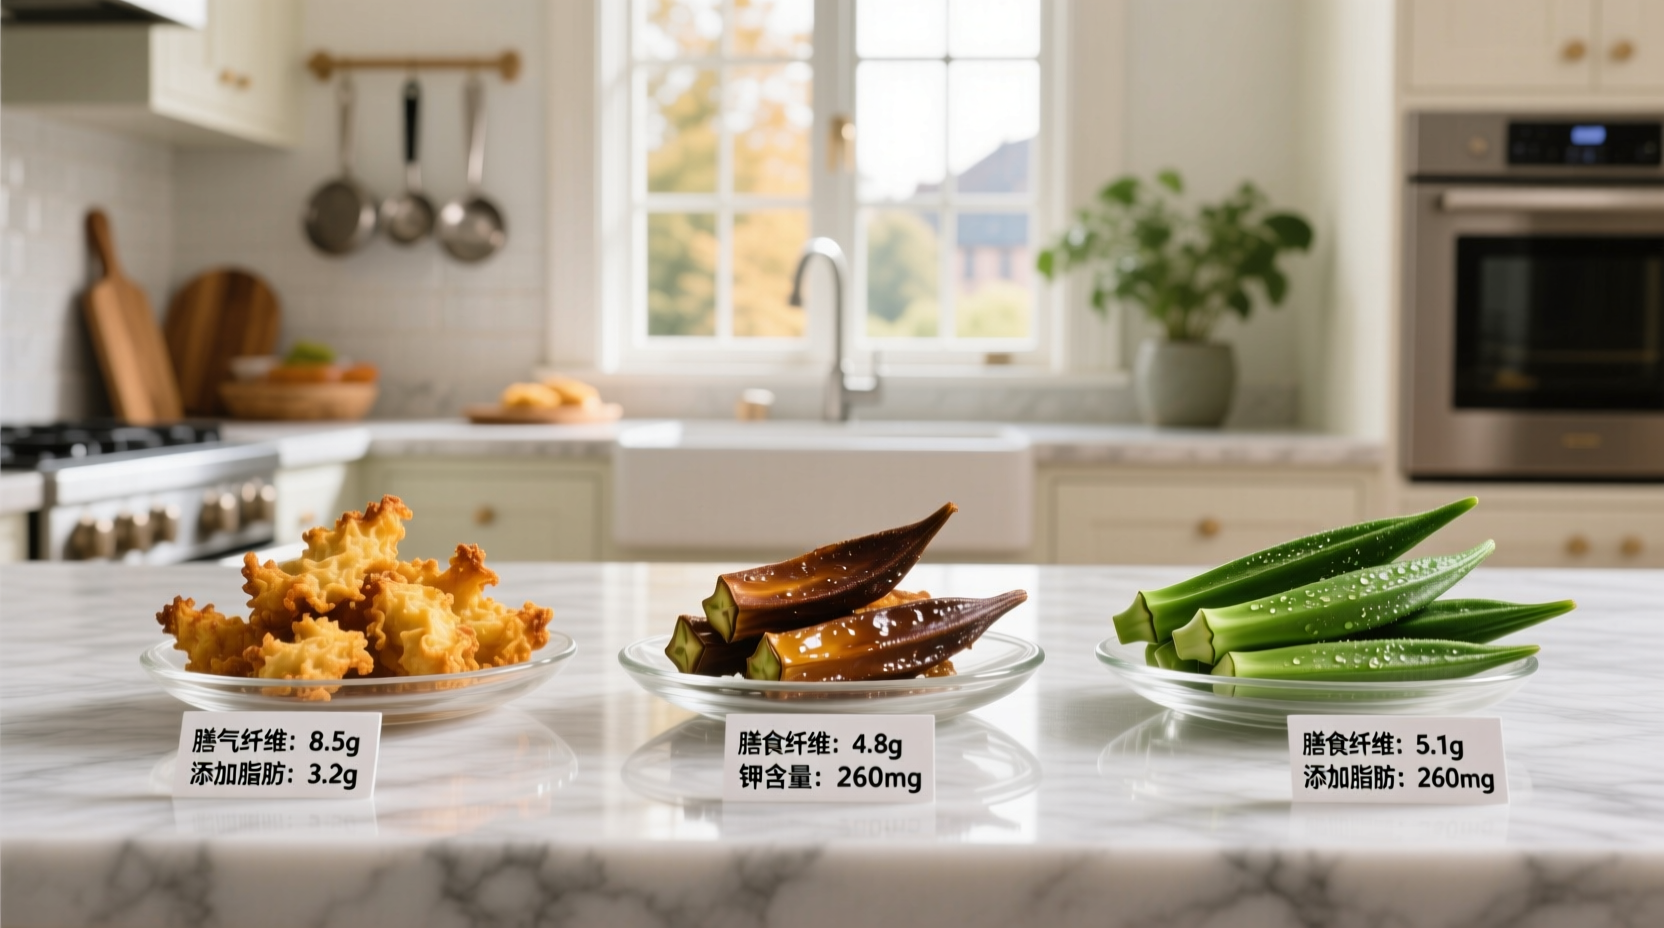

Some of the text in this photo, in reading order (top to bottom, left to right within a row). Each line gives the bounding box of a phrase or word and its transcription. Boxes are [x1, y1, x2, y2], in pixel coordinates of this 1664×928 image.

[309, 731, 360, 757] 8.5g
[738, 730, 902, 760] 膳食纤维： 4.8g
[1303, 731, 1464, 761] 膳食纤维： 5.1g
[190, 761, 358, 790] 添加脂肪： 3.2g
[739, 763, 922, 793] 钾含量： 260mg
[1303, 764, 1494, 794] 添加脂肪： 260mg
